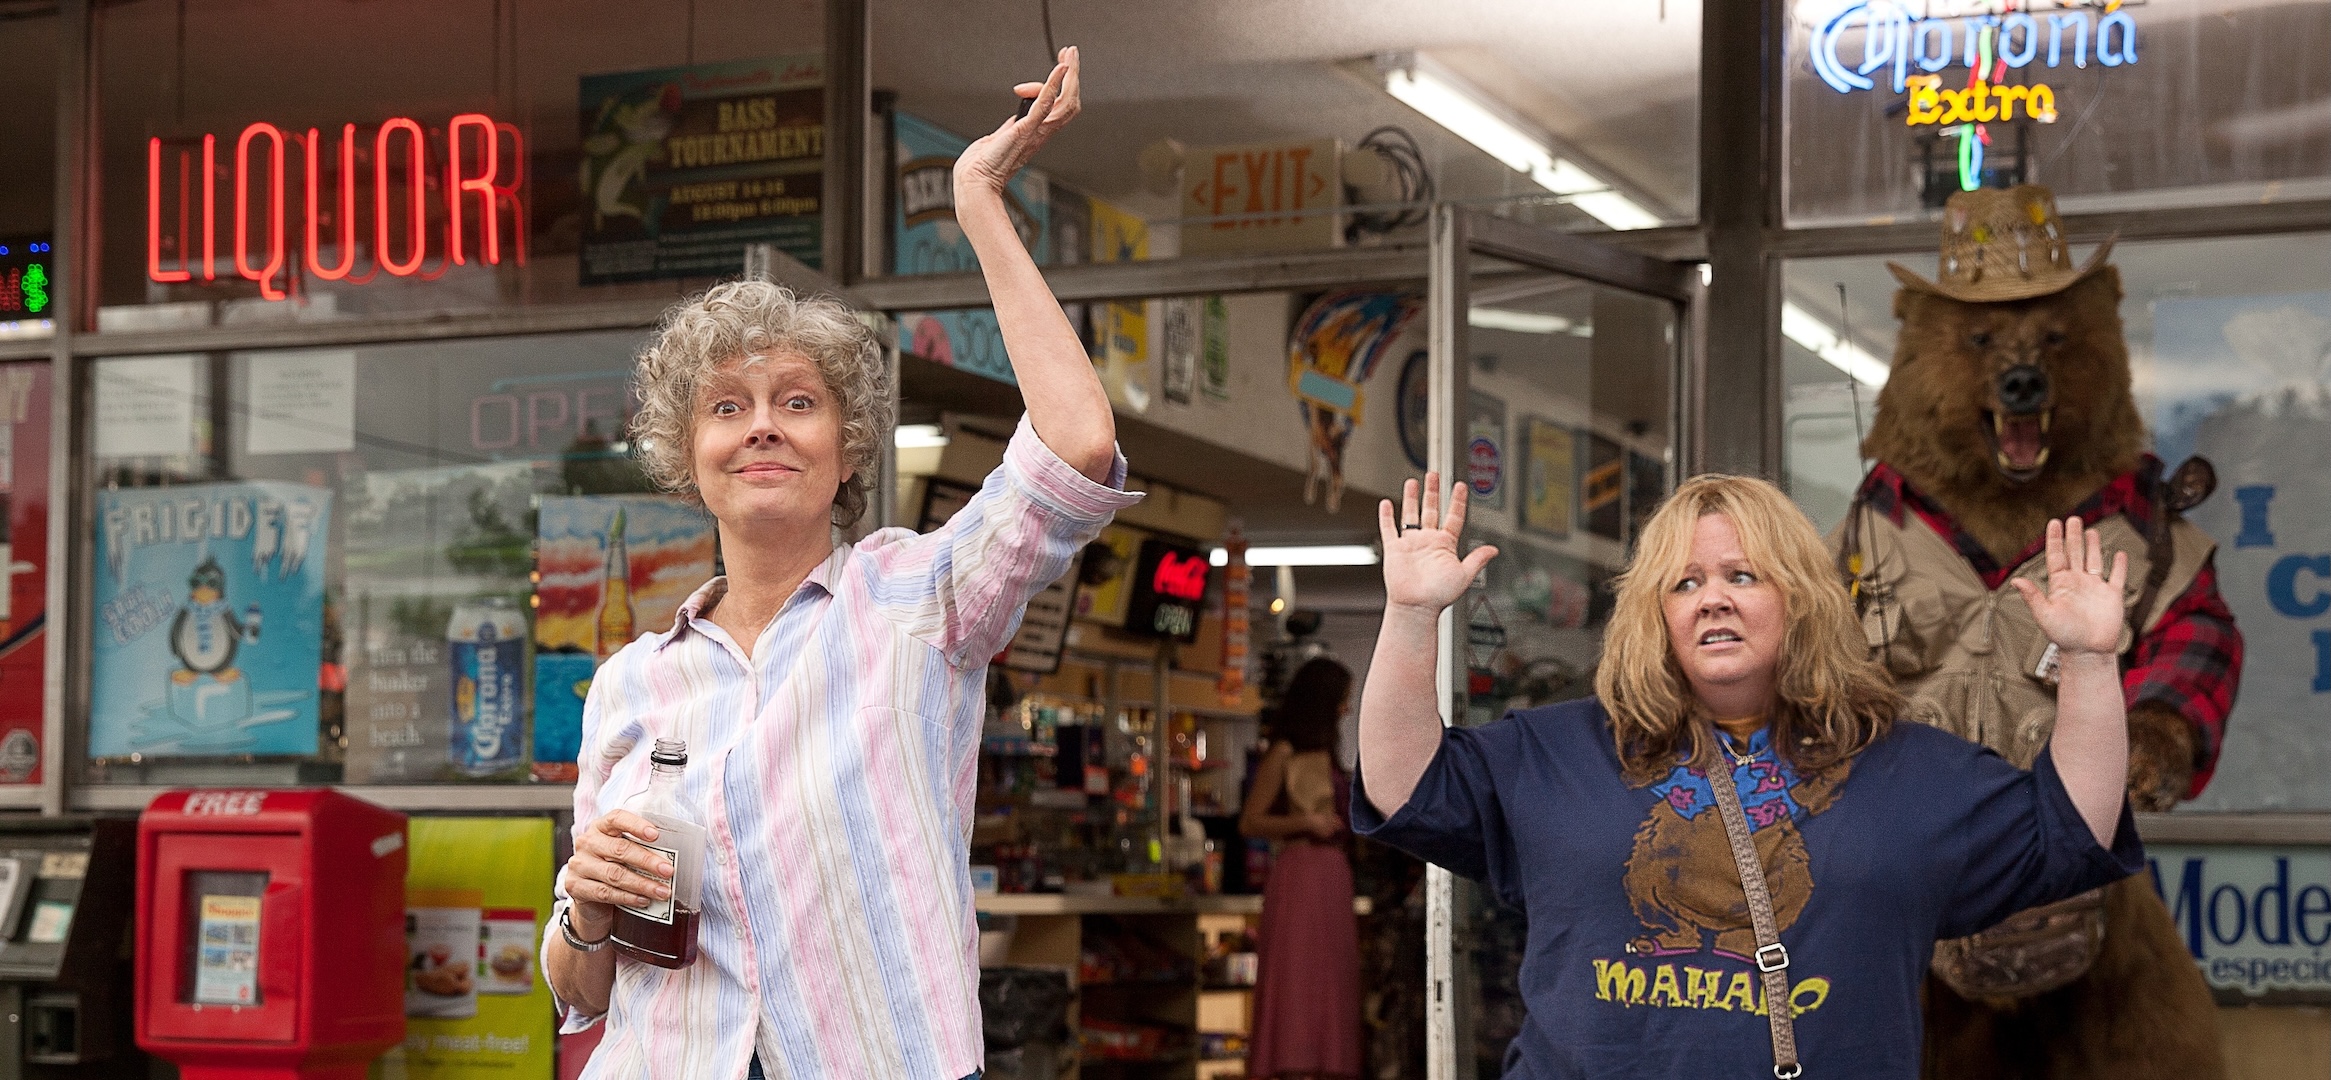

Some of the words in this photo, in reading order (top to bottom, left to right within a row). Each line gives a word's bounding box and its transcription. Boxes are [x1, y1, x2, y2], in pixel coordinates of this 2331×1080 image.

[1809, 2, 2138, 94] Corona
[718, 98, 776, 133] BASS
[1905, 74, 2059, 126] Extra
[669, 124, 823, 169] TOURNAMENT
[149, 113, 498, 300] LIQUOR
[671, 181, 738, 204] AUGUST
[1213, 148, 1311, 230] EXIT
[471, 387, 634, 449] OPE
[2234, 485, 2275, 549] I
[369, 669, 430, 693] bunker
[473, 645, 501, 758] Corona
[182, 791, 269, 816] FREE
